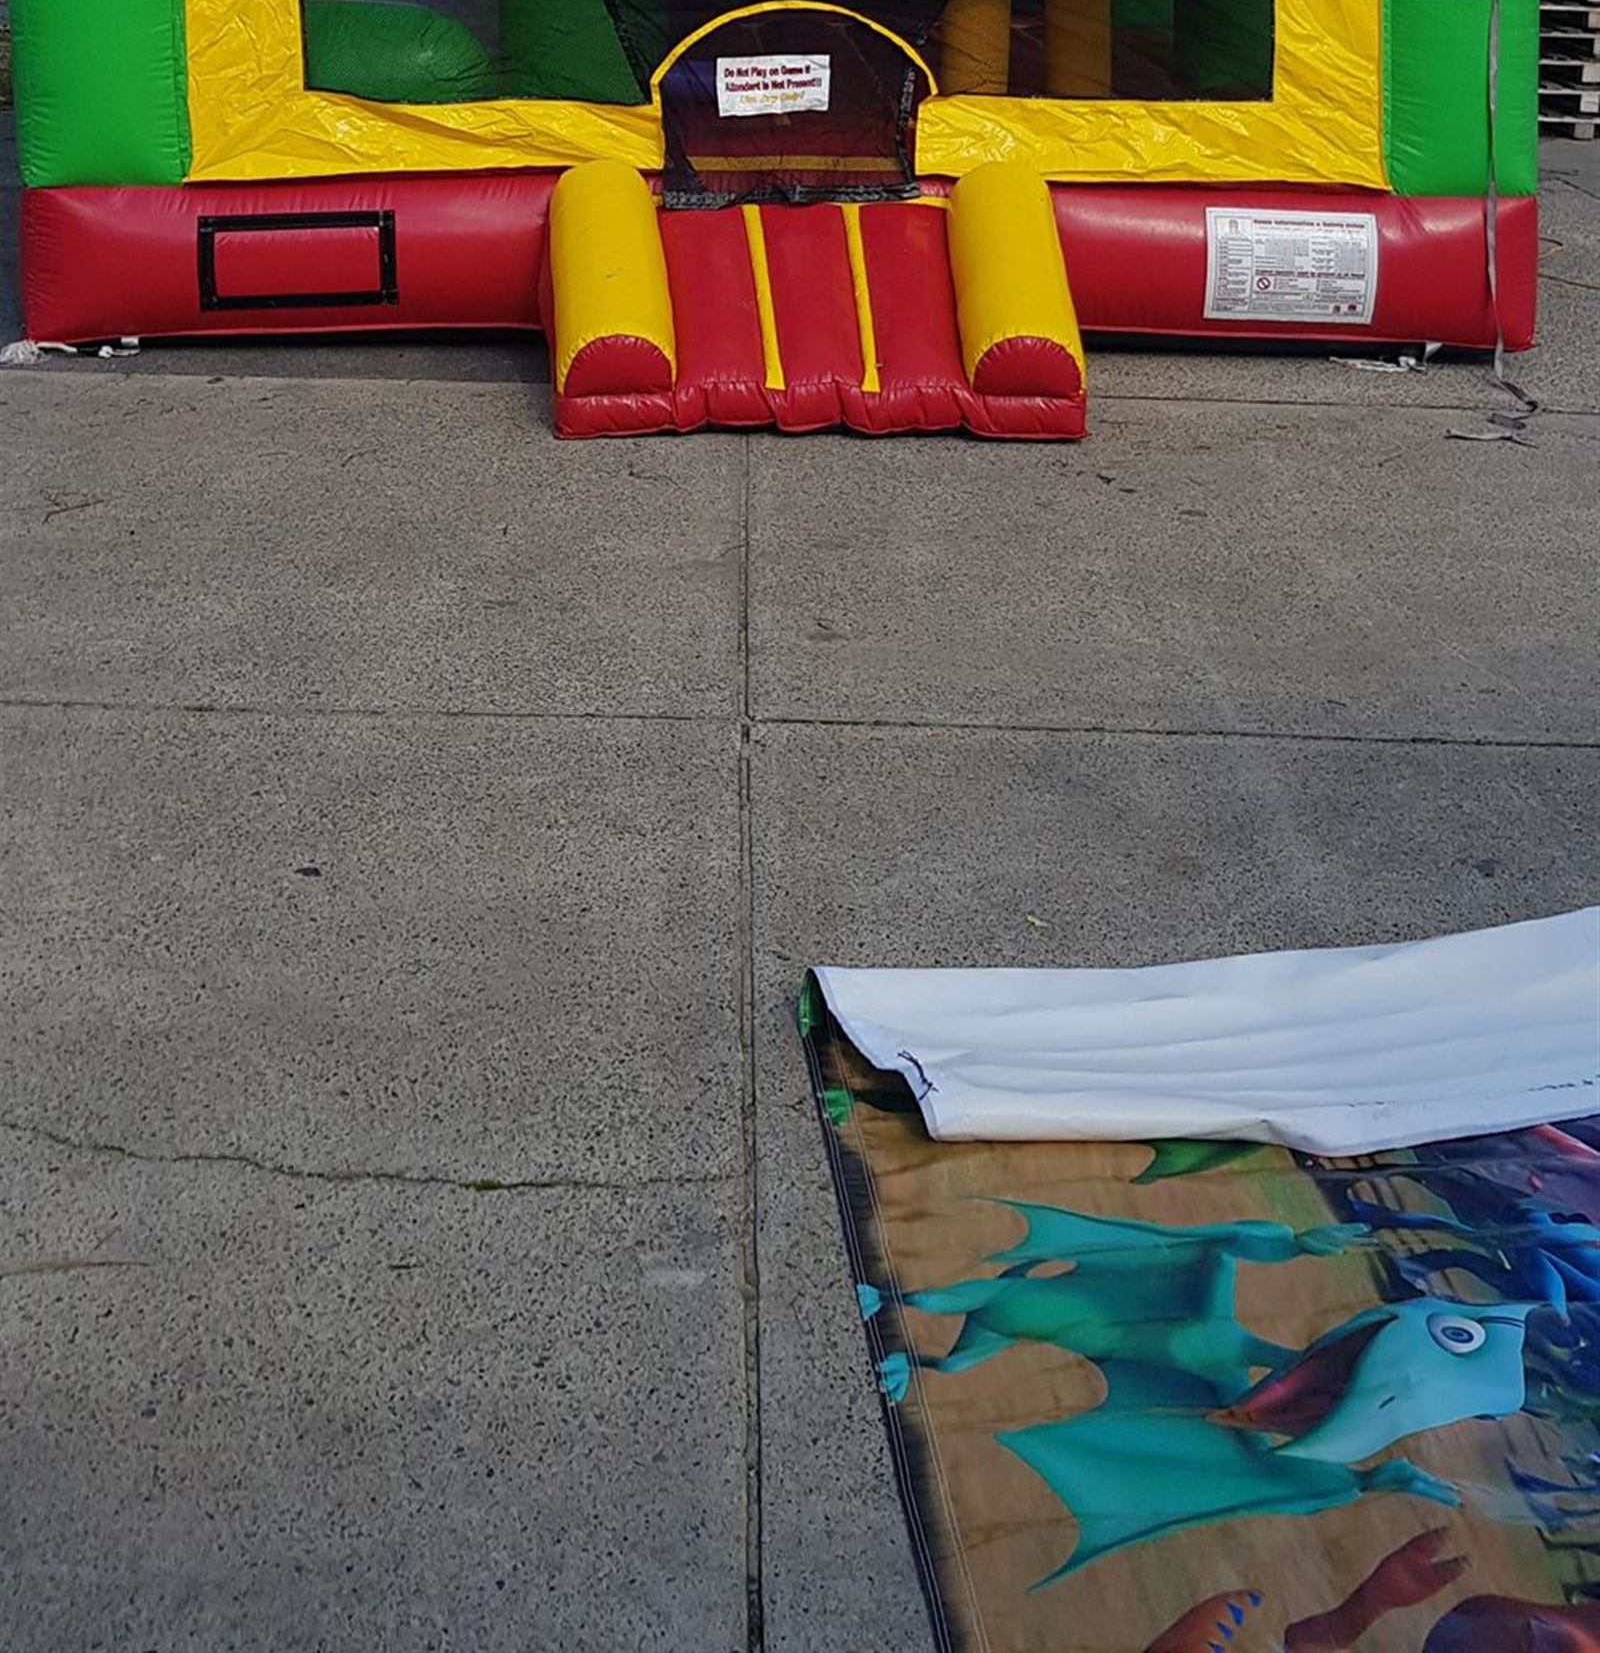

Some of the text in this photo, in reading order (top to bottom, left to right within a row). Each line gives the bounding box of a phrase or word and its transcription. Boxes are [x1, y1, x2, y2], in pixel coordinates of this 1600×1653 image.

[724, 68, 735, 78] Do
[736, 68, 749, 77] Not
[751, 67, 767, 78] Play
[769, 67, 779, 76] on
[781, 65, 803, 75] Game
[771, 80, 785, 90] Not
